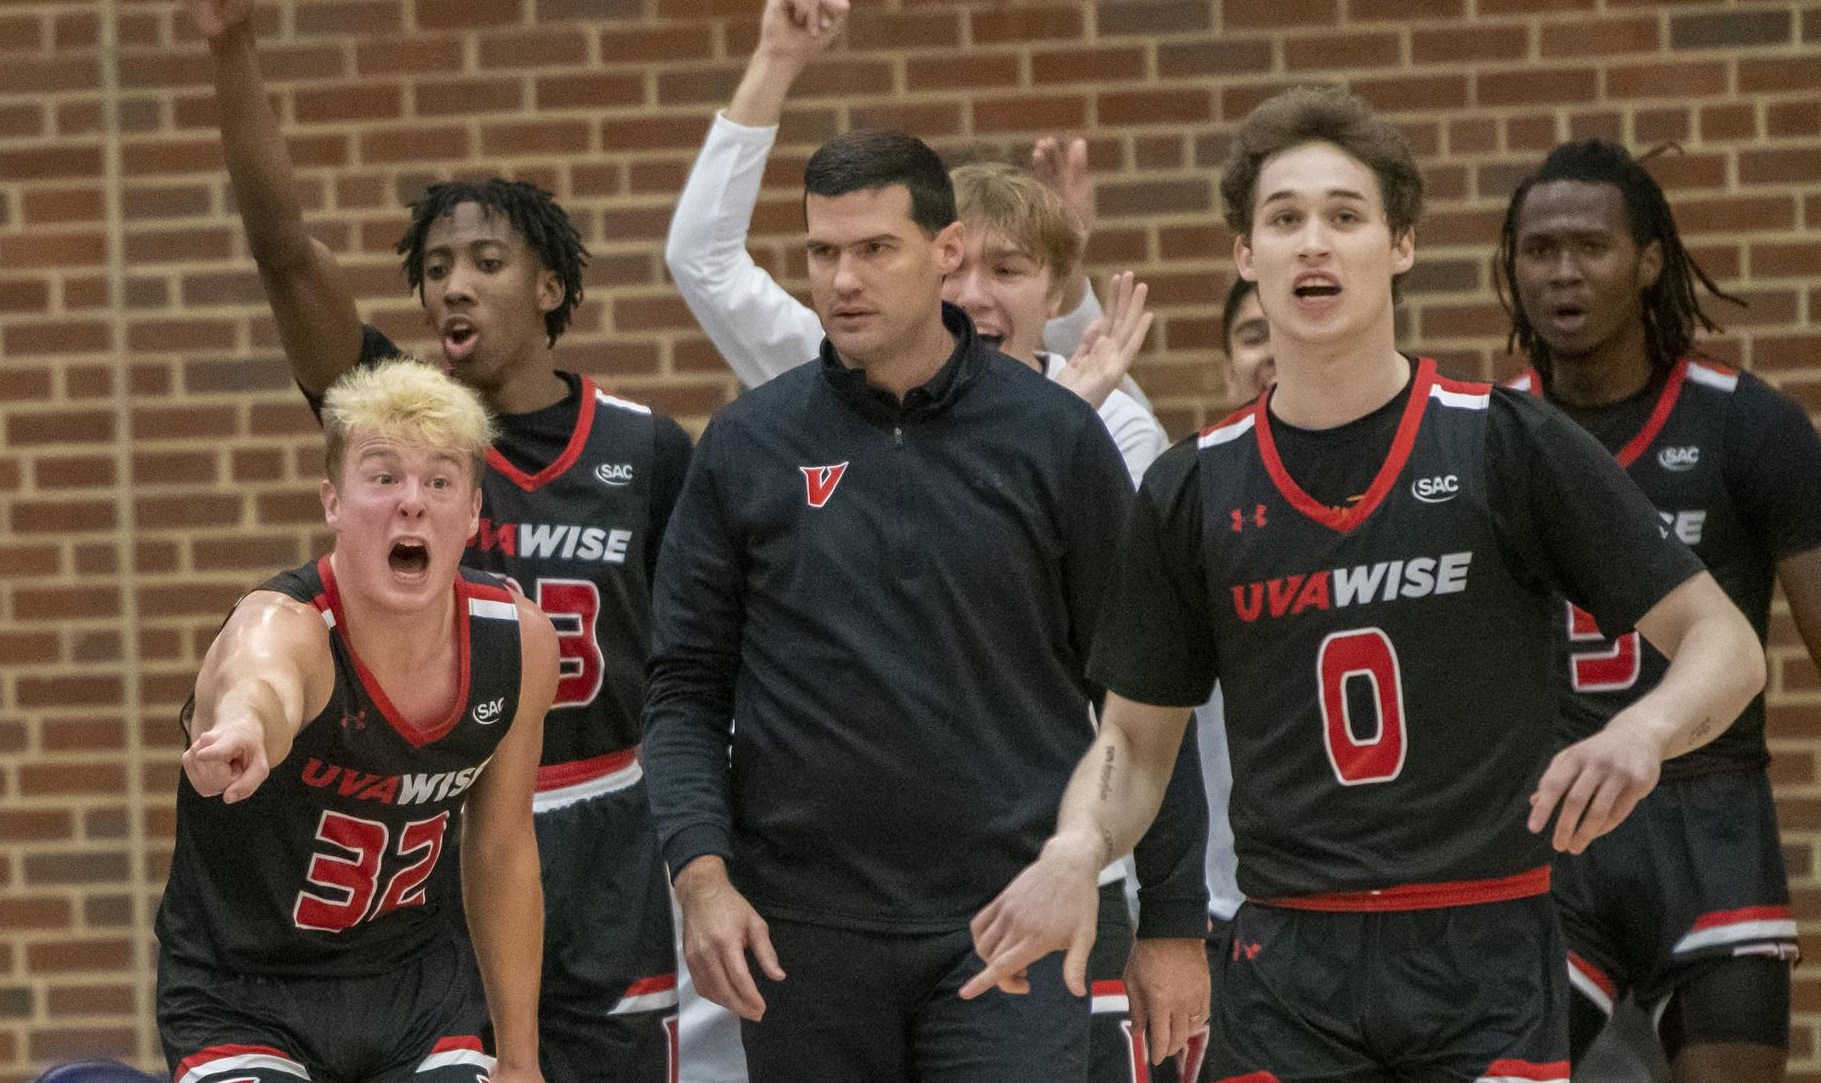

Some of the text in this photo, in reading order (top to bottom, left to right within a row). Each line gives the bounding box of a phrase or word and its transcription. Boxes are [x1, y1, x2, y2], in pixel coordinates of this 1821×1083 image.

[601, 463, 633, 480] SAC
[1664, 445, 1700, 464] SAC
[799, 461, 849, 508] V
[1418, 475, 1459, 496] SAC
[1231, 552, 1474, 622] UVAWISE
[1317, 626, 1408, 787] 0
[293, 809, 450, 934] 32
